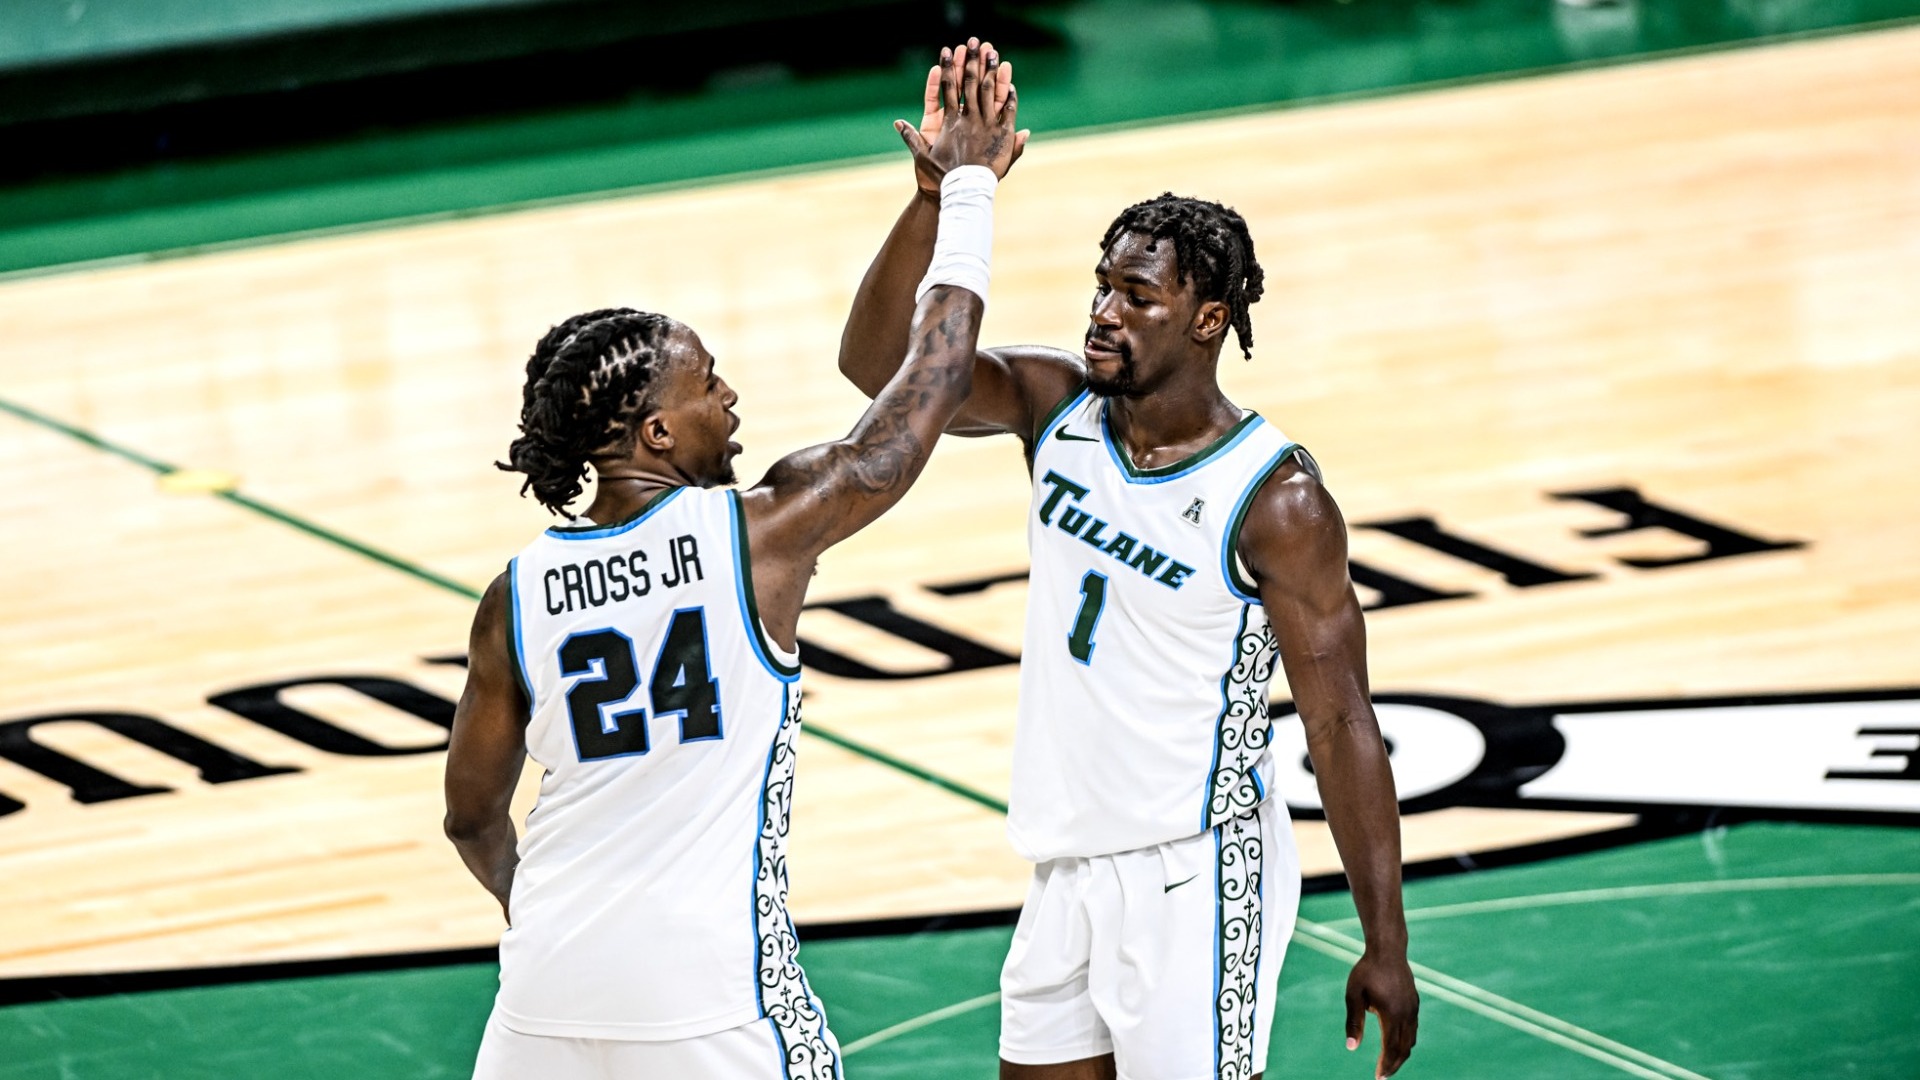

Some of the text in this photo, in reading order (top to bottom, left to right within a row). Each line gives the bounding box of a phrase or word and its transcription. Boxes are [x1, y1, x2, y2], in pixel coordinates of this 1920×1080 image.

[543, 534, 704, 616] CROSS JR
[1039, 468, 1197, 591] TULANE
[1067, 568, 1109, 666] 1
[556, 605, 724, 763] 24
